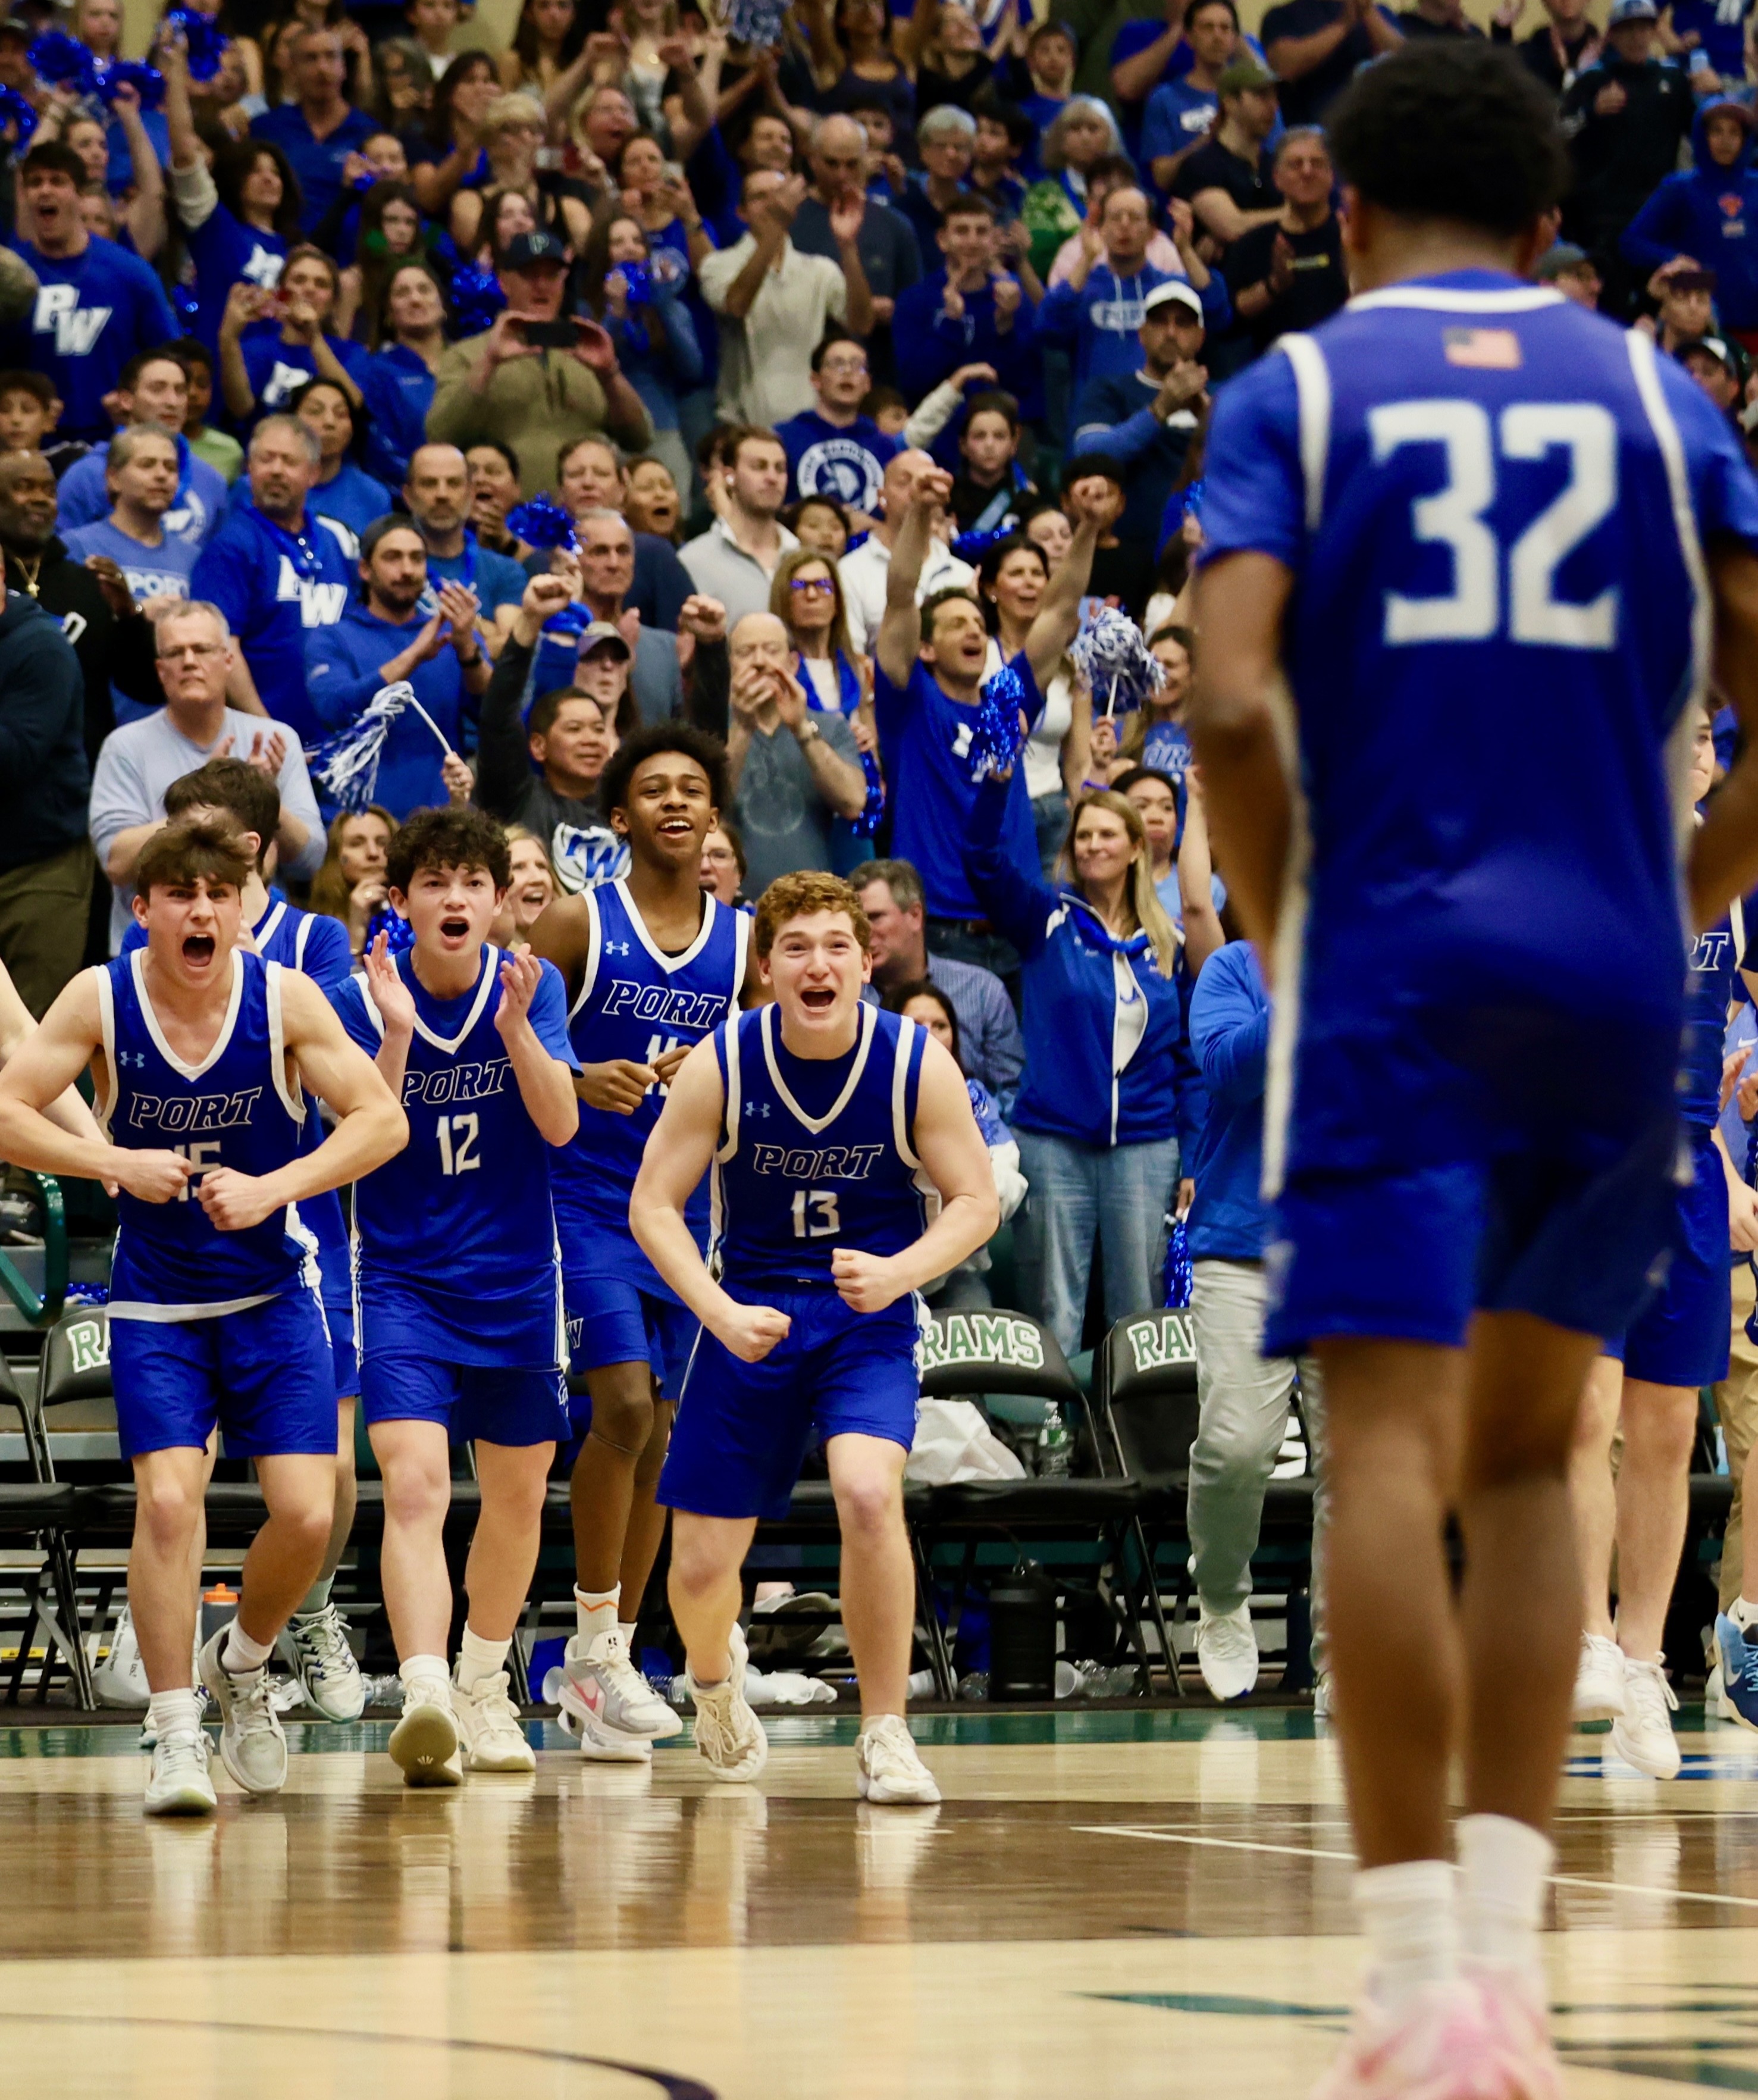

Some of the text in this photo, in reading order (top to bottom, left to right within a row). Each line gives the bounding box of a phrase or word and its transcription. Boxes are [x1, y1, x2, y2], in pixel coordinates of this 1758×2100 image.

[33, 283, 114, 356] PW
[1367, 397, 1621, 651] 32
[601, 979, 727, 1029] PORT
[401, 1056, 513, 1107] PORT
[129, 1085, 263, 1132] PORT
[435, 1112, 481, 1176] 12
[754, 1143, 885, 1181] PORT
[790, 1190, 841, 1238] 13
[922, 1314, 1045, 1370] RAMS
